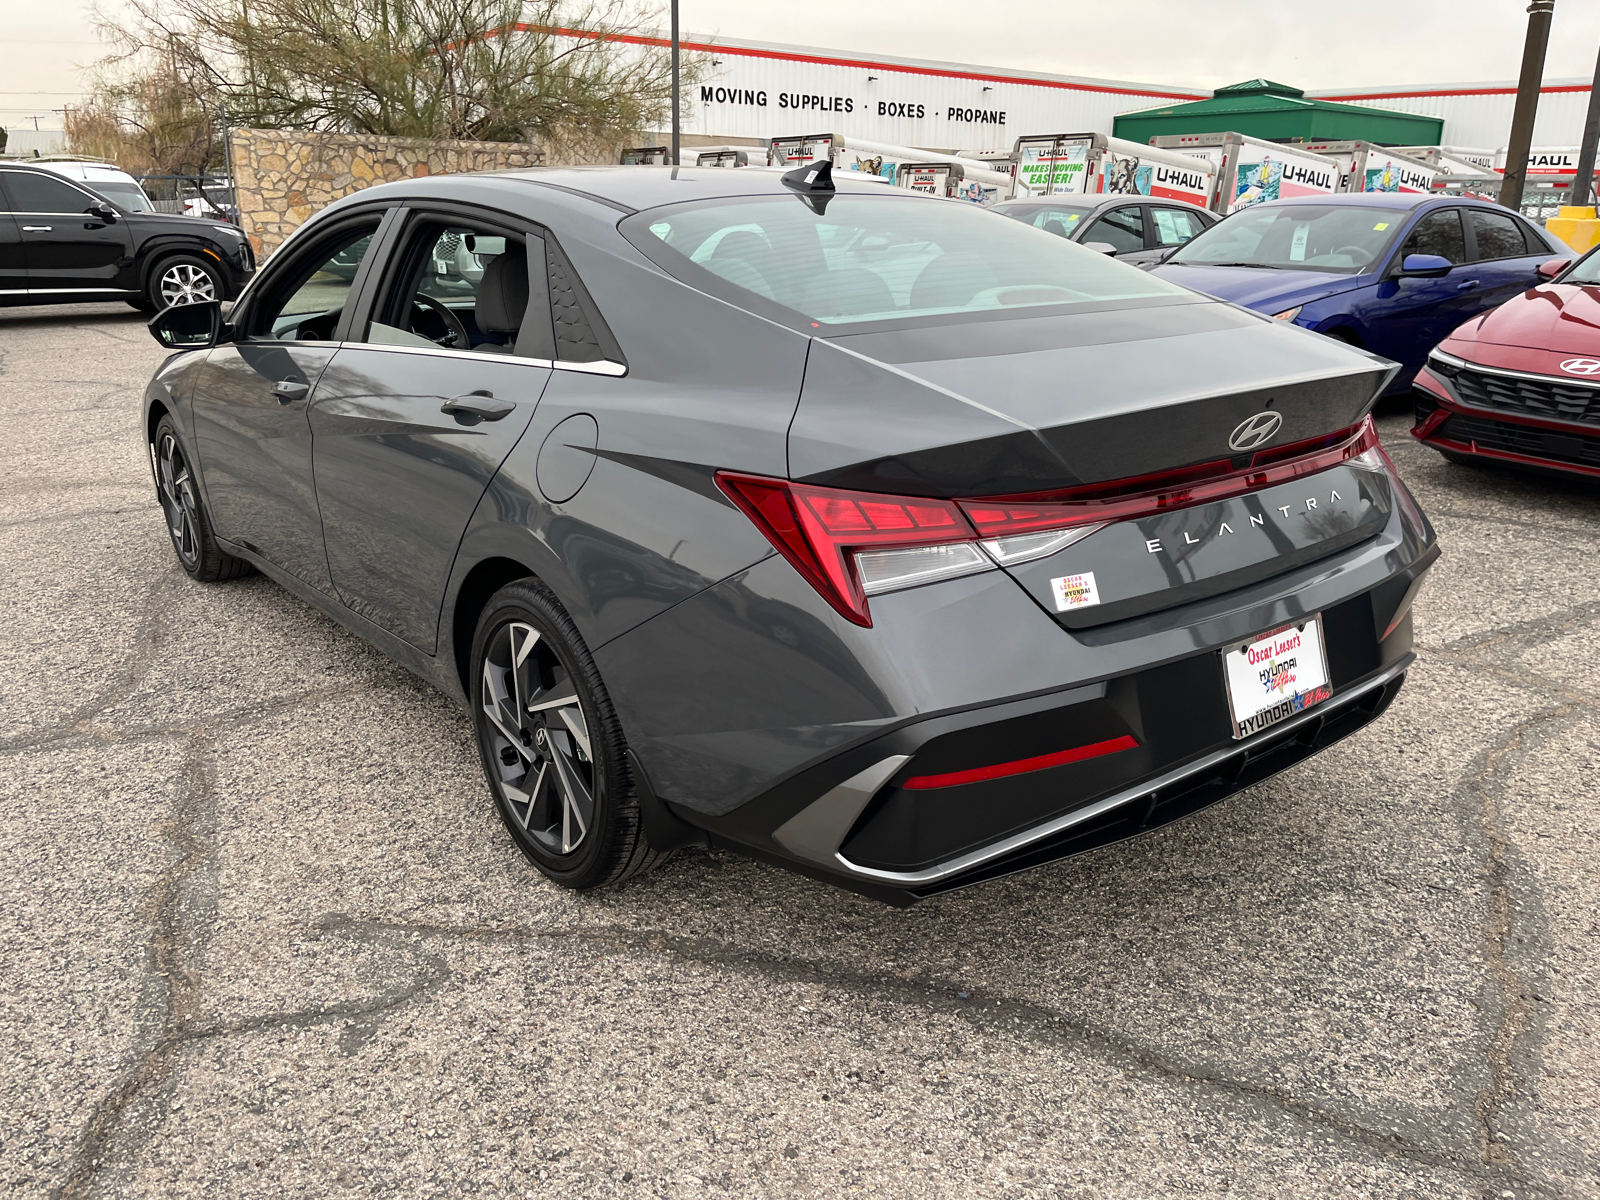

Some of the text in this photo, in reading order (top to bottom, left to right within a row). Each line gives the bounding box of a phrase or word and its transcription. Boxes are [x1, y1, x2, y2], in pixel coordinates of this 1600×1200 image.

[700, 85, 1006, 125] MOVING SUPPLIES BOXES PROPANE
[1022, 163, 1084, 173] MAKES MOVING
[1029, 173, 1074, 184] EASIER!
[1157, 166, 1204, 190] U-HAUL
[1283, 163, 1332, 189] U-HAUL
[1145, 490, 1342, 554] ELANTRA
[1063, 576, 1082, 584] OSCAR
[1248, 633, 1301, 665] Oscar Leeser's
[1259, 657, 1297, 681] HYUNDAI
[1239, 700, 1293, 737] HYUNDAI
